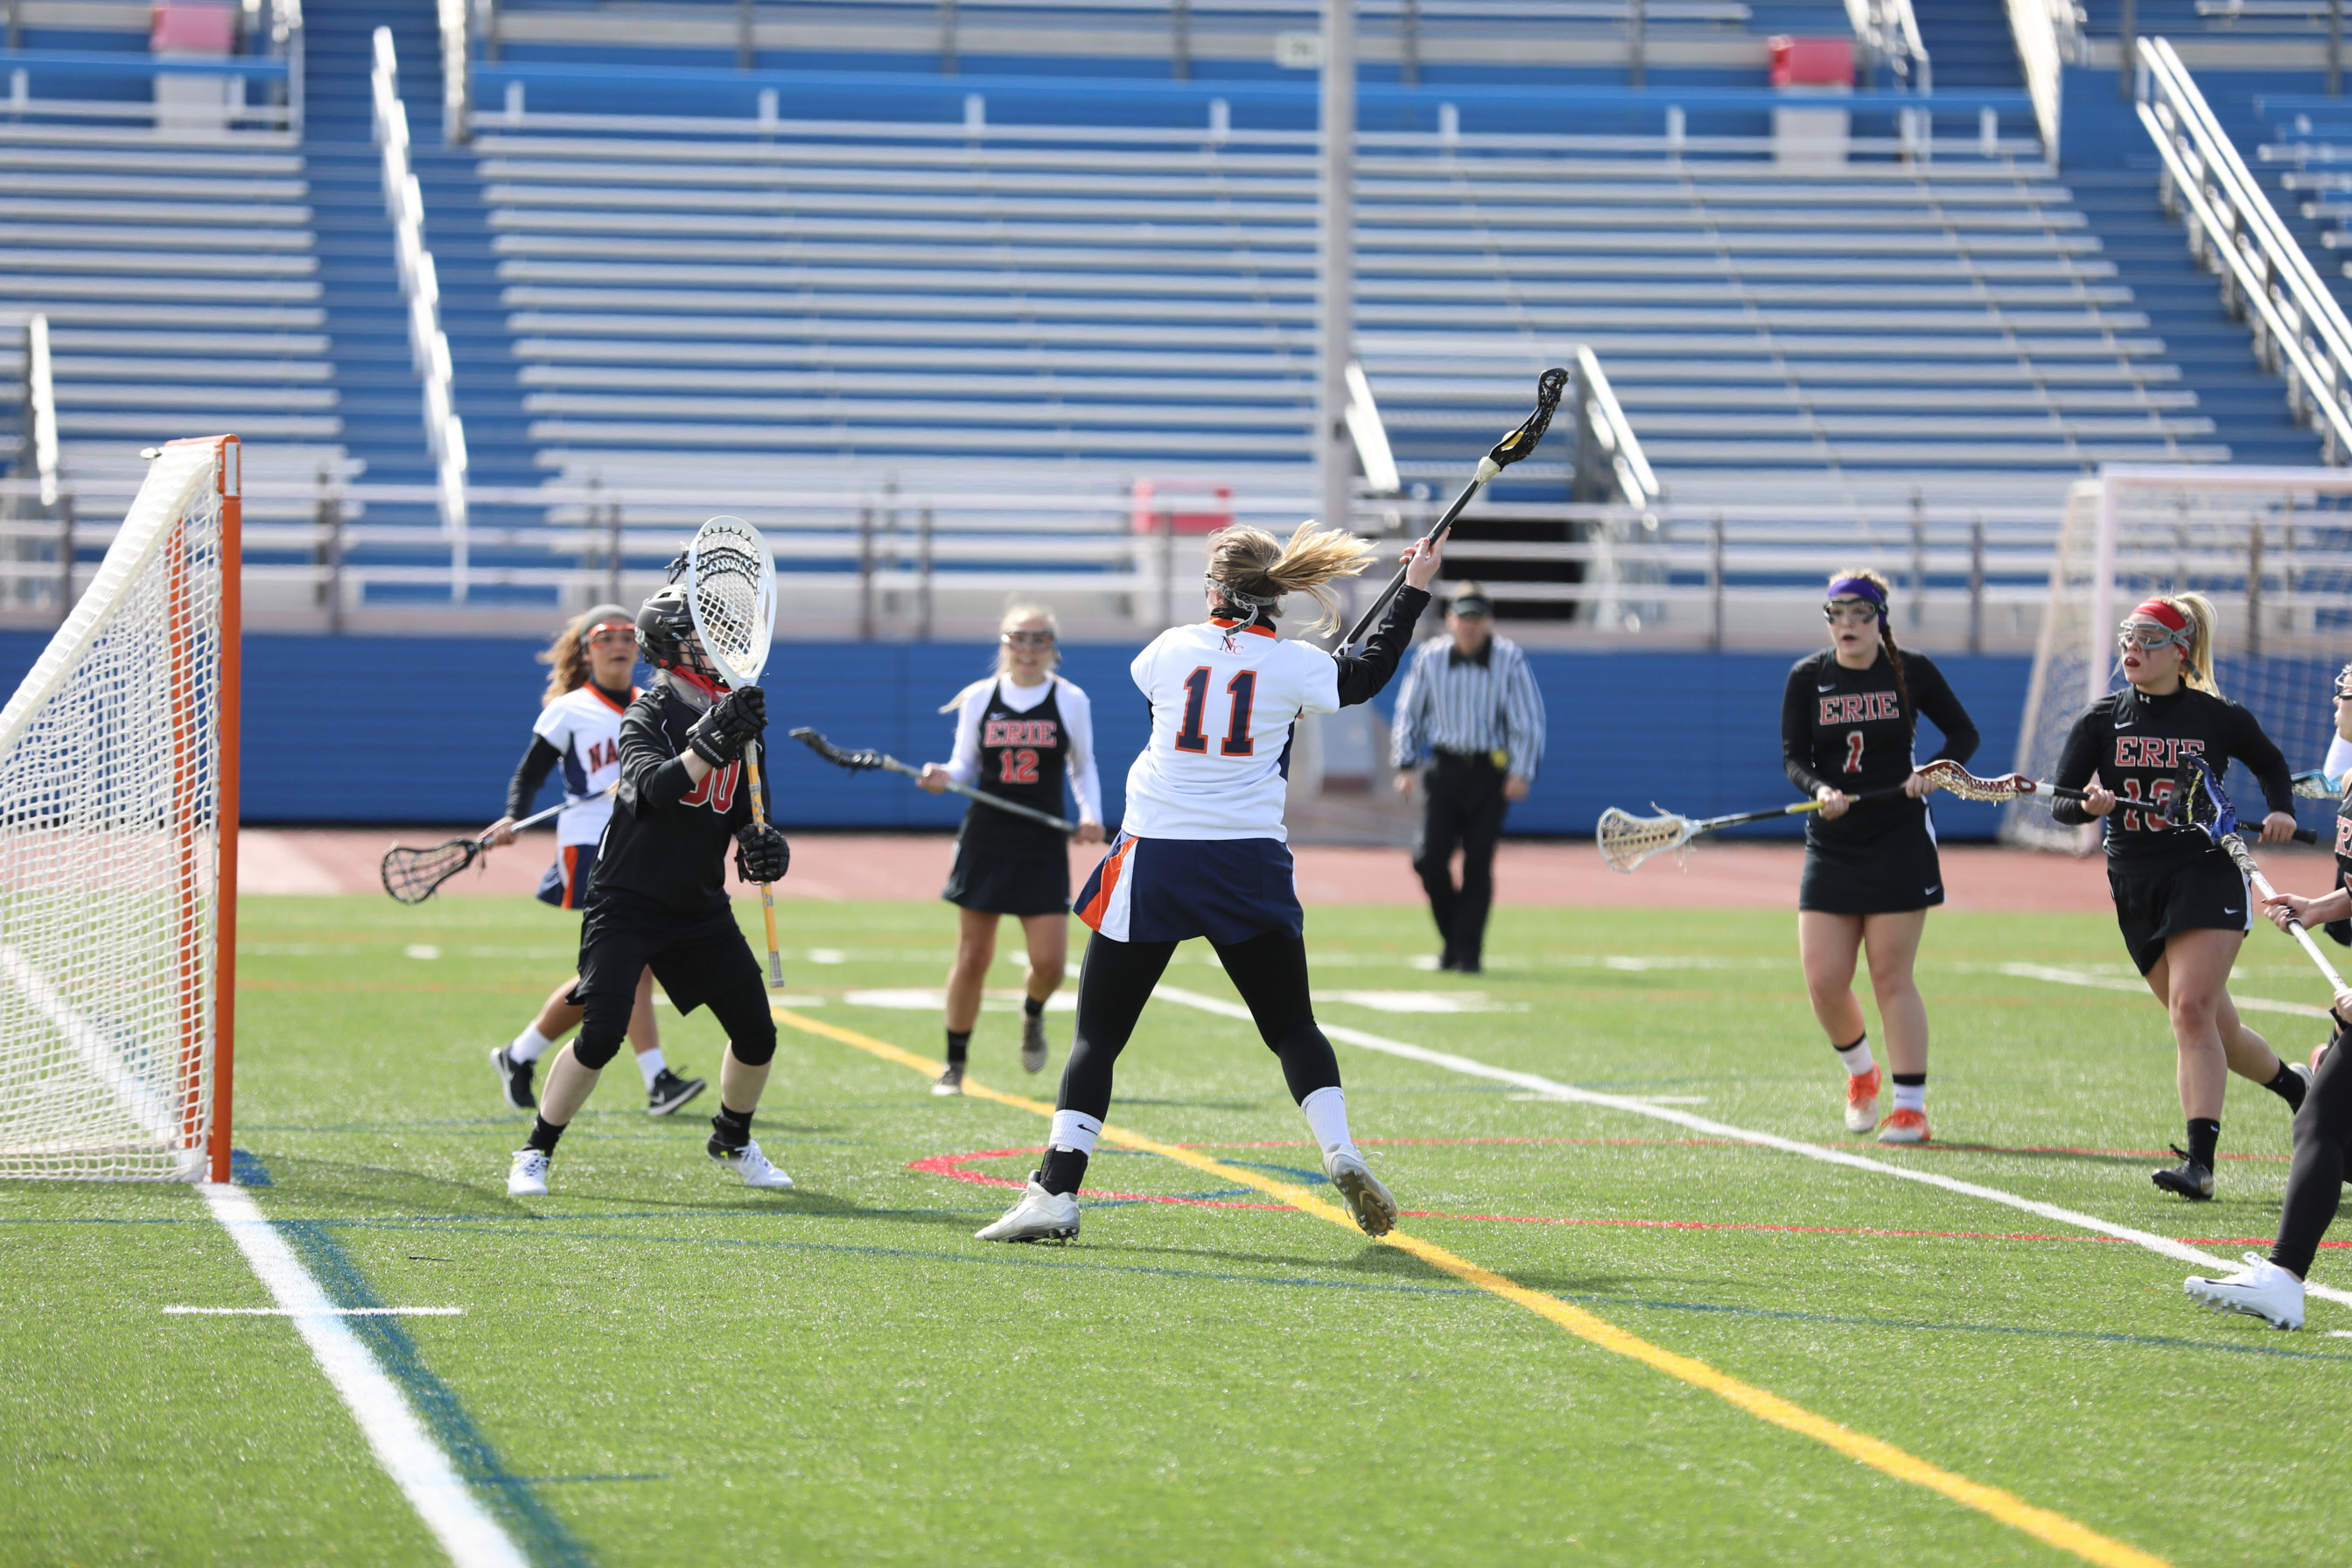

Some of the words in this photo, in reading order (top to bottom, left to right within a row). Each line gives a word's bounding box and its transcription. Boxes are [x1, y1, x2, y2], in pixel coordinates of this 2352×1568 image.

[1175, 666, 1257, 757] 11
[1819, 690, 1899, 725] ERIE
[984, 719, 1057, 747] ERIE
[999, 748, 1040, 784] 12
[1843, 731, 1864, 774] 1
